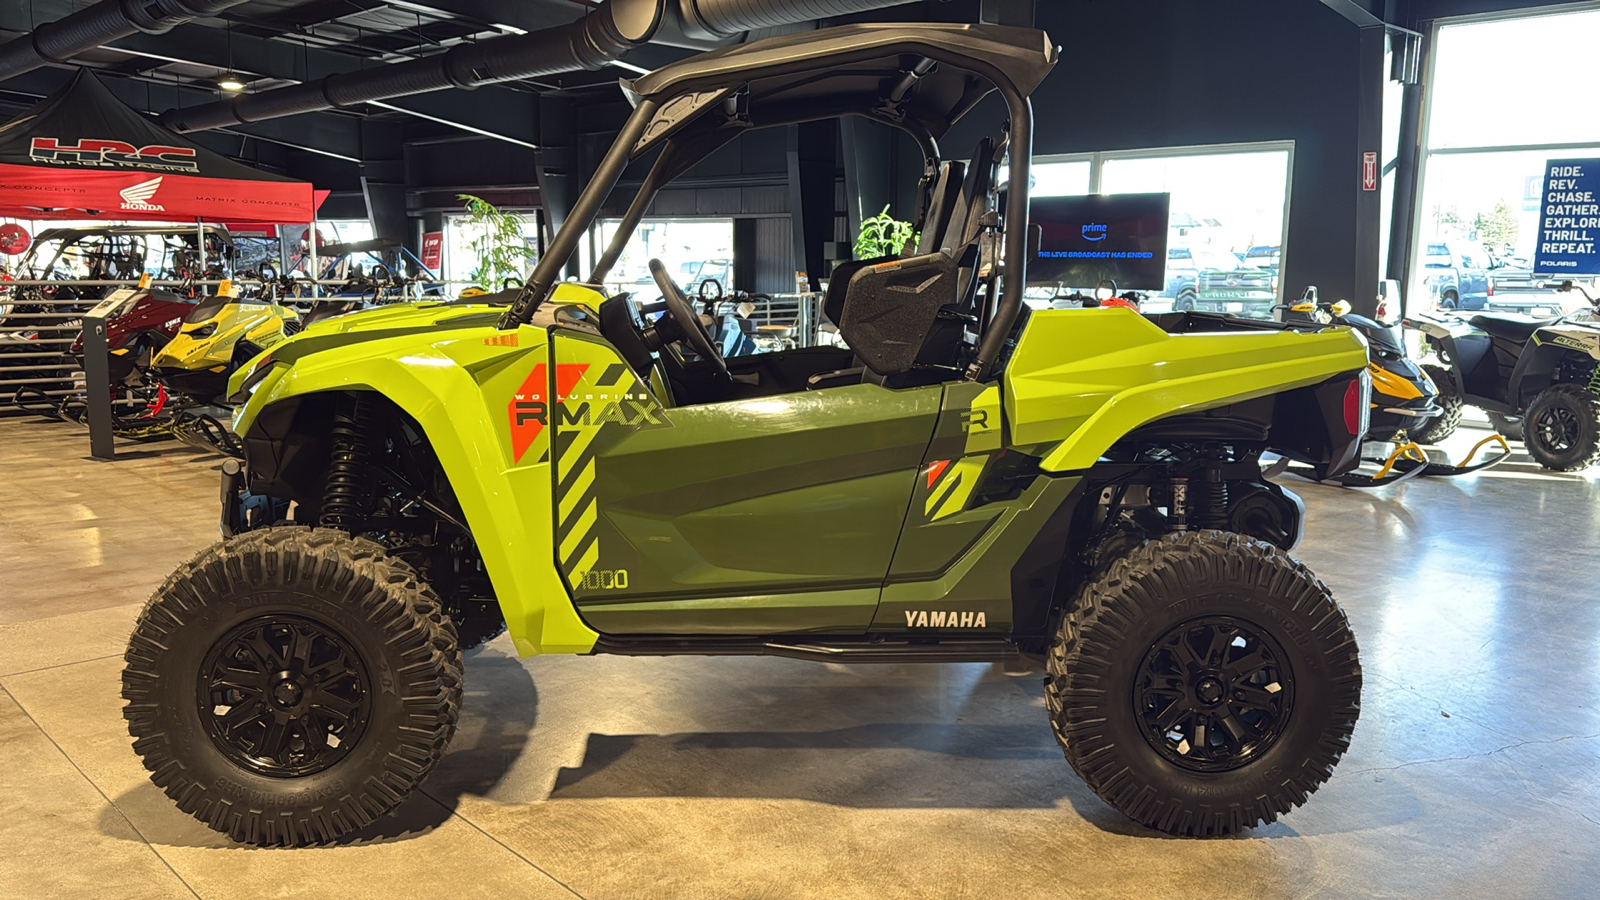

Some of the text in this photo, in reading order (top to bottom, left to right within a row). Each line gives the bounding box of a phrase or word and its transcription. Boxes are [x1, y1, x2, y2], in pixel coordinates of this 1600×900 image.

[29, 137, 197, 169] HRC
[1550, 166, 1585, 177] RIDE.
[13, 184, 86, 193] CONCEPTS
[1548, 179, 1579, 190] REV.
[241, 199, 300, 207] CONCEPTS
[1547, 191, 1596, 203] CHASE.
[120, 202, 165, 212] HONDA
[1081, 222, 1108, 234] prime
[1543, 230, 1594, 241] THRILL.
[1541, 242, 1596, 254] REPEAT.
[1554, 335, 1596, 352] ALTERRA
[515, 401, 662, 426] RMAX
[960, 409, 989, 433] R
[580, 569, 629, 590] 1000
[904, 611, 987, 628] YAMAHA
